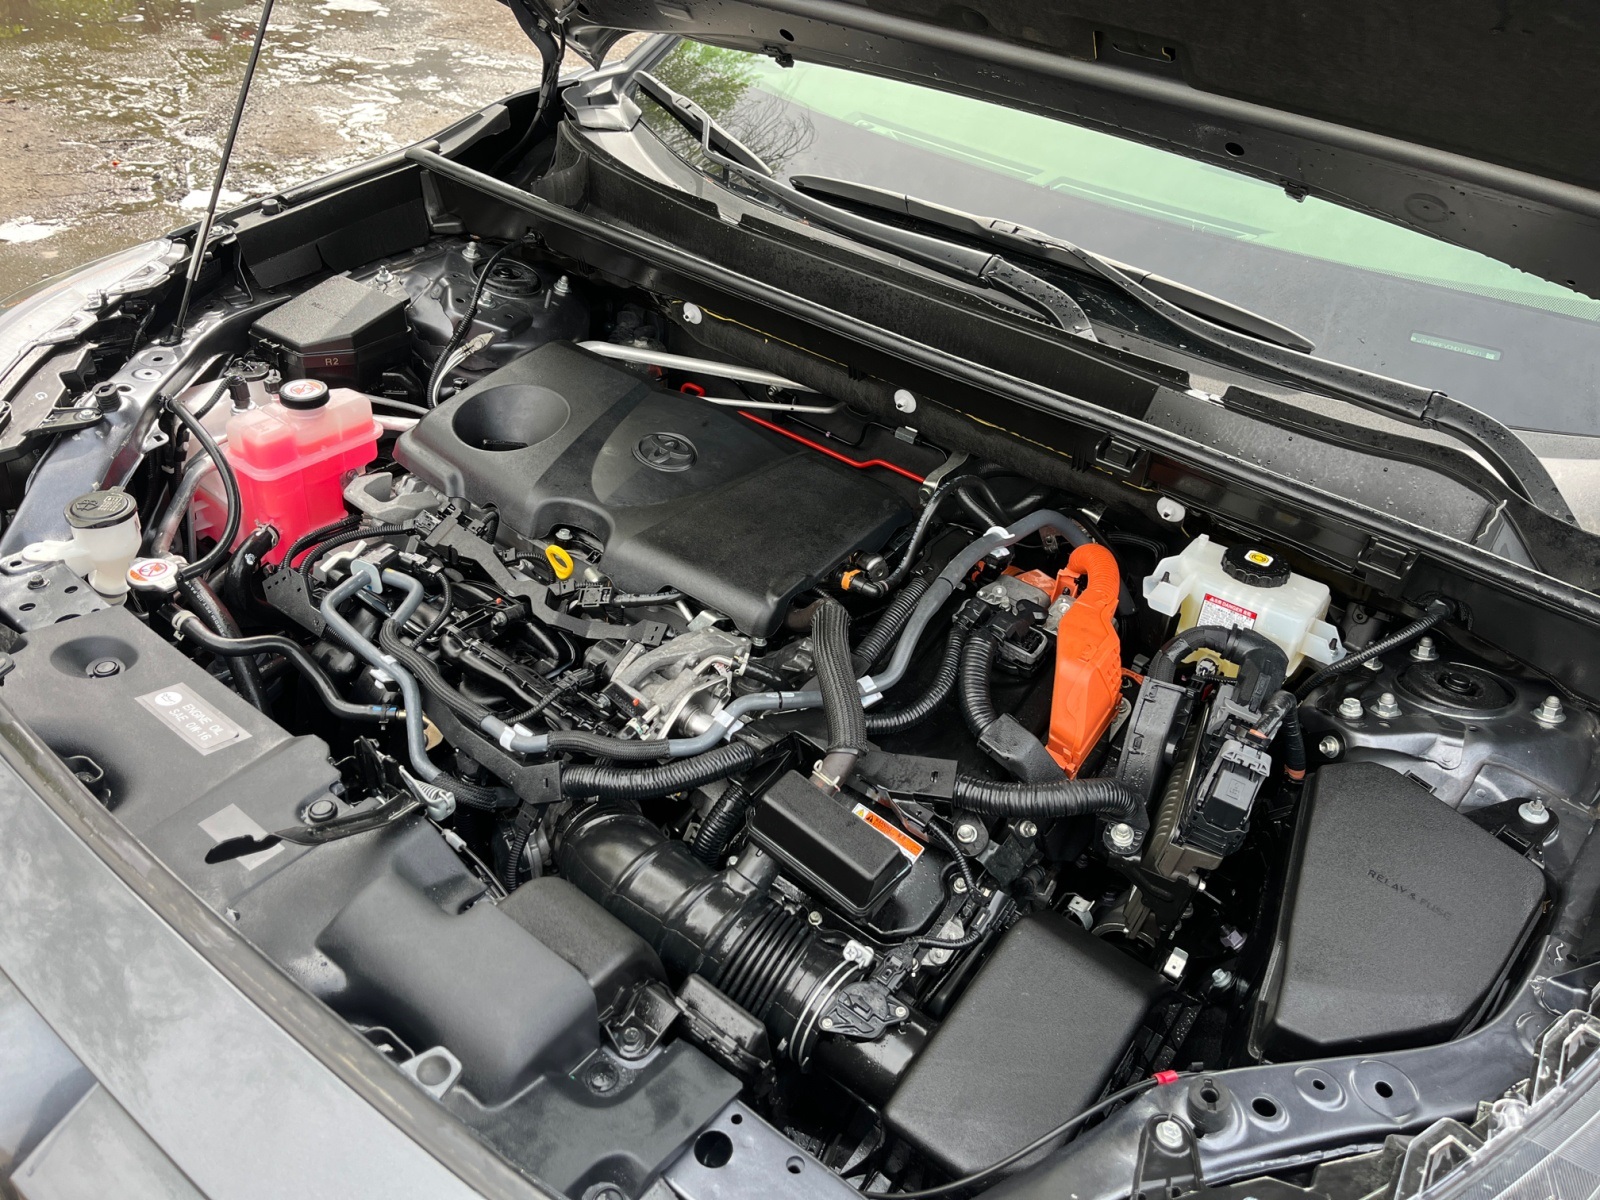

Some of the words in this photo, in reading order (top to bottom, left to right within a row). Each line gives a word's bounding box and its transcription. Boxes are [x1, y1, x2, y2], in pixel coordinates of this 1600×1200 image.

[325, 358, 340, 366] R2
[1222, 601, 1243, 614] DANGER
[168, 708, 189, 722] SAE
[182, 703, 213, 725] ENGINE
[209, 724, 224, 736] OIL
[1368, 869, 1407, 893] RELAY
